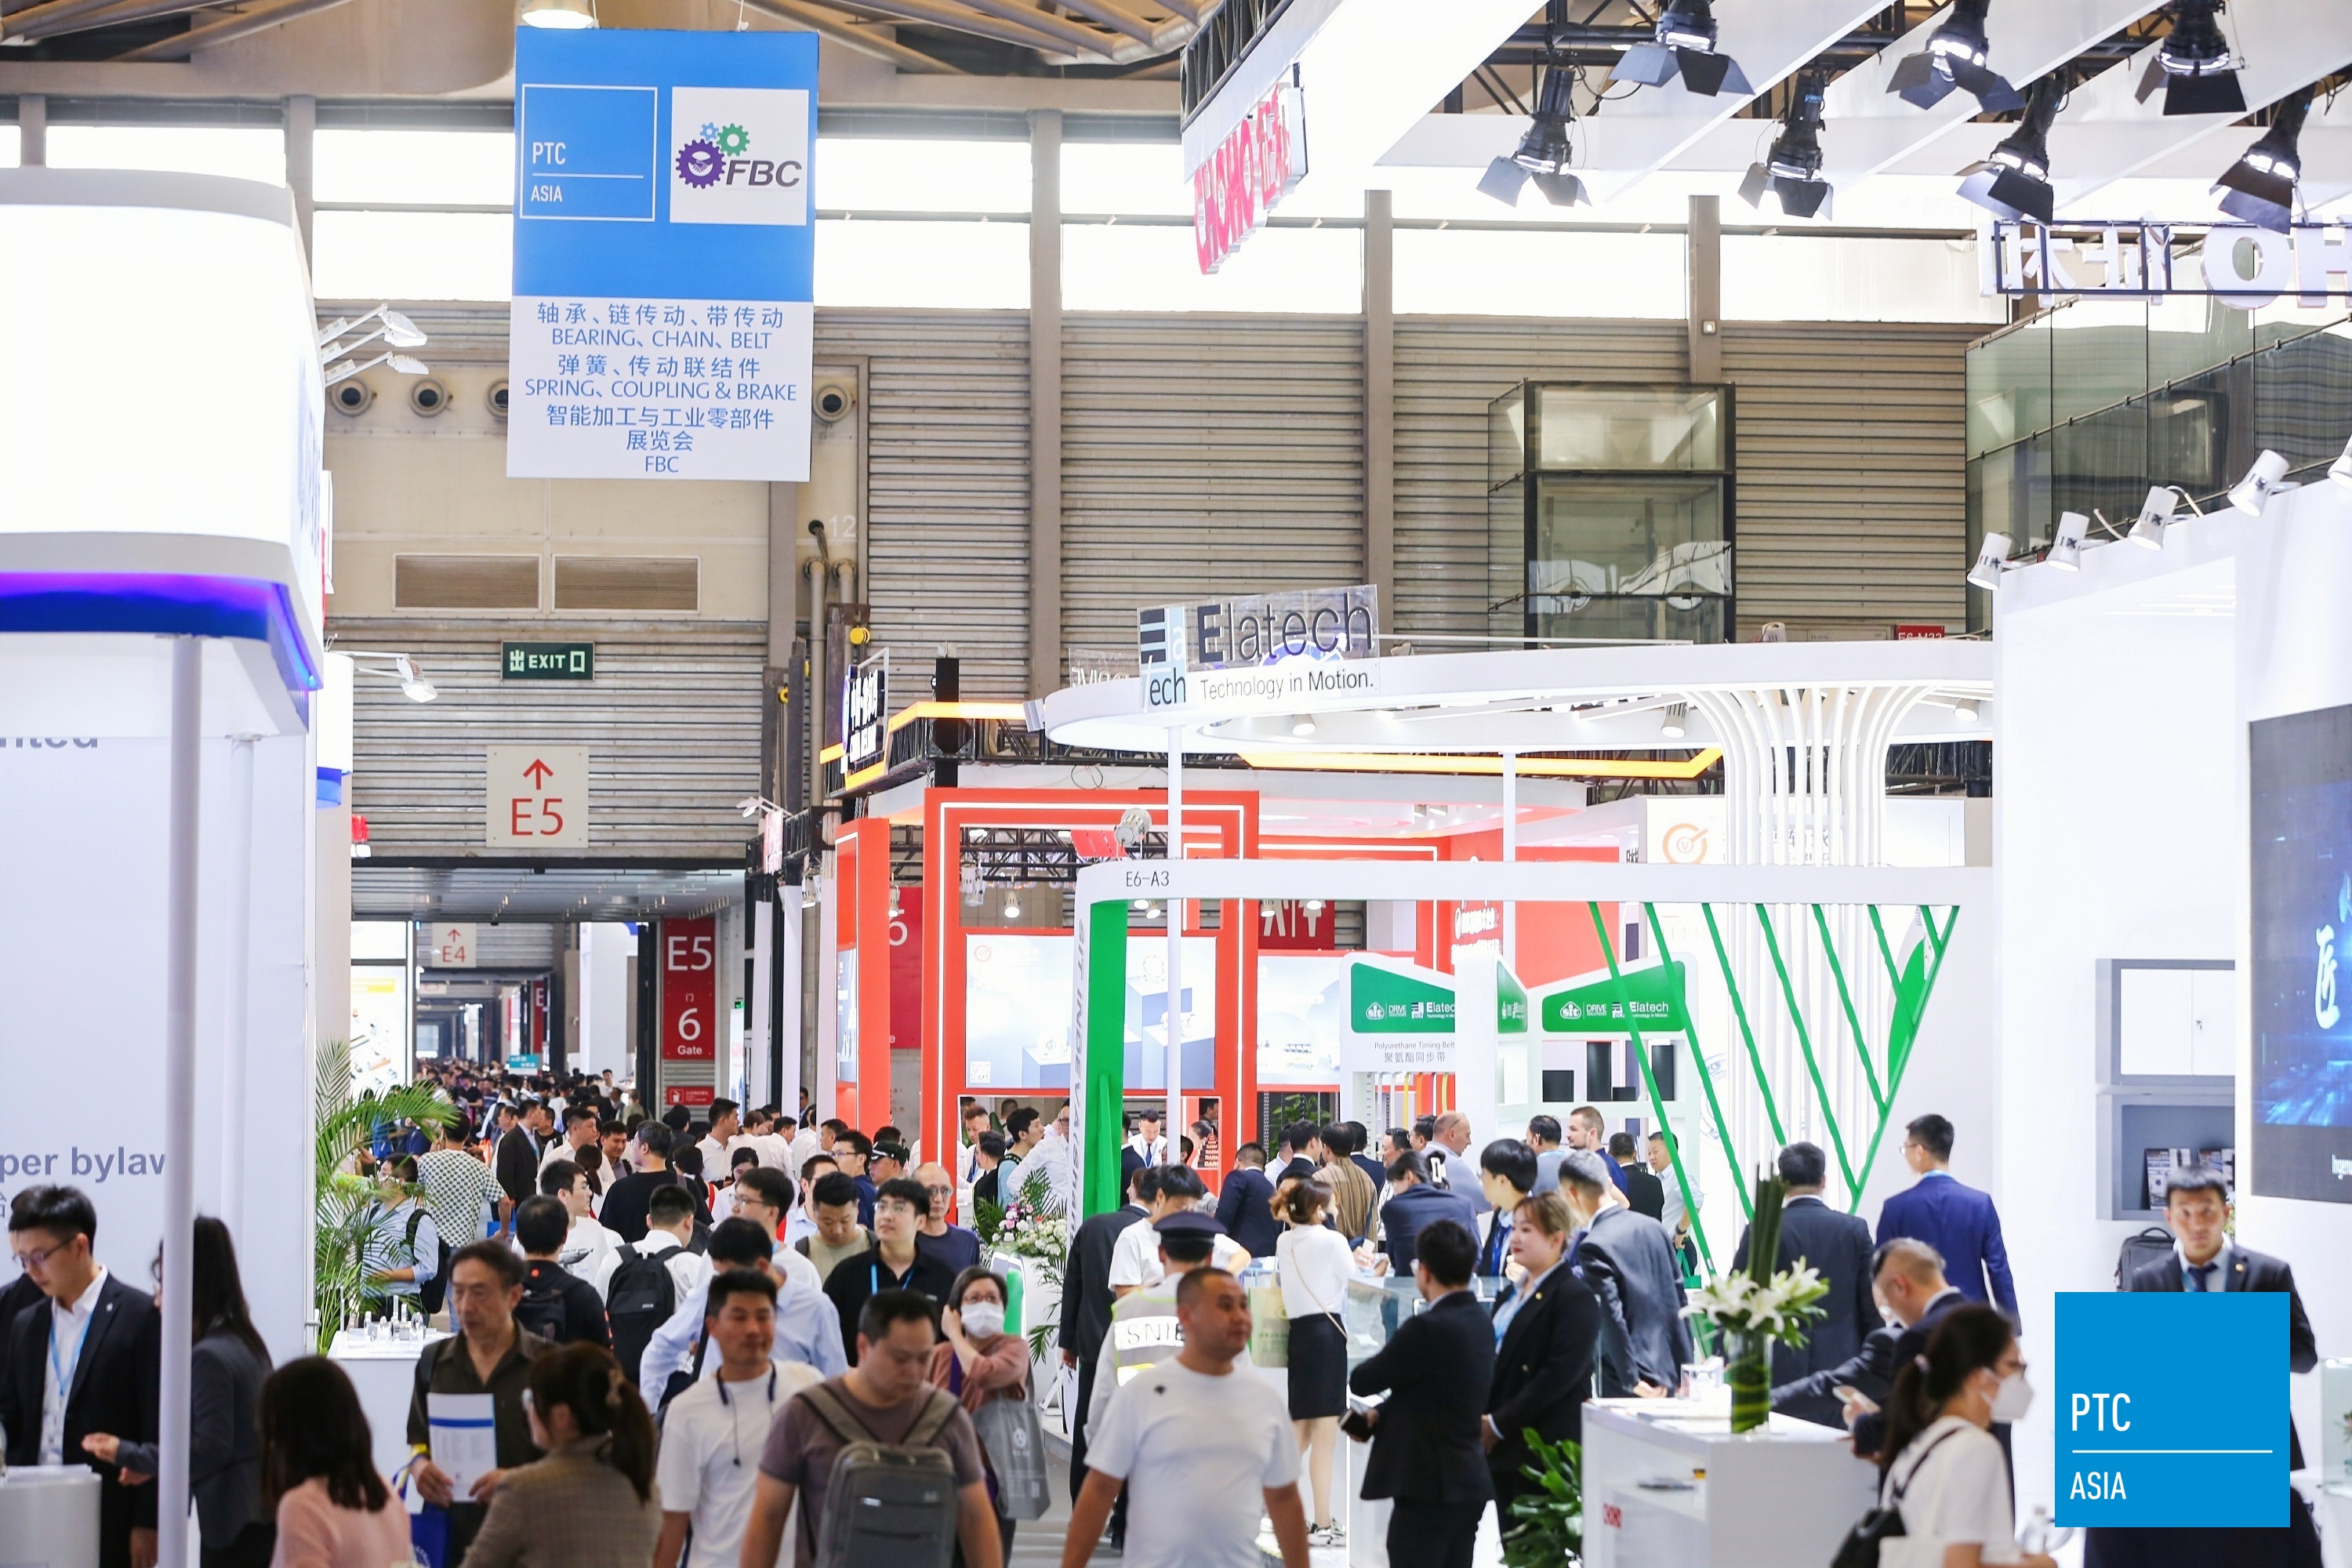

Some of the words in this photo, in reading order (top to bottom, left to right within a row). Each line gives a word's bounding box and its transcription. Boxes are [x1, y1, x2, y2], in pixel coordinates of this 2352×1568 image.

[532, 142, 566, 165] PTC
[726, 160, 802, 187] FBC
[531, 185, 563, 203] ASIA
[538, 302, 783, 328] 轴承、链传动、带传动
[731, 332, 772, 350] BELT
[558, 354, 760, 379] 弹簧、传动联结件
[612, 381, 710, 400] COUPLING
[715, 382, 731, 401] &
[738, 383, 797, 401] BRAKE
[546, 405, 775, 430] 智能加工与工业零部件
[626, 430, 694, 452] 展览会
[645, 456, 679, 474] FBC
[828, 515, 857, 538] 12
[1197, 592, 1374, 663] Elatech
[510, 649, 525, 672] 出
[528, 655, 566, 669] EXIT
[570, 651, 586, 673] 口
[1200, 675, 1284, 700] Technology
[1290, 673, 1302, 693] in
[1308, 670, 1374, 691] Motion.
[511, 797, 564, 836] E5
[1126, 871, 1170, 887] E6-A3
[442, 946, 466, 963] E4
[668, 936, 712, 971] E5
[1586, 1004, 1606, 1012] DRIVE
[1629, 1001, 1669, 1012] Elatech
[678, 1007, 701, 1040] 6
[677, 1045, 702, 1055] Gate
[1374, 1042, 1417, 1051] Polyurethane
[1418, 1042, 1441, 1051] Timing
[1384, 1051, 1446, 1063] 聚氨酯同步带
